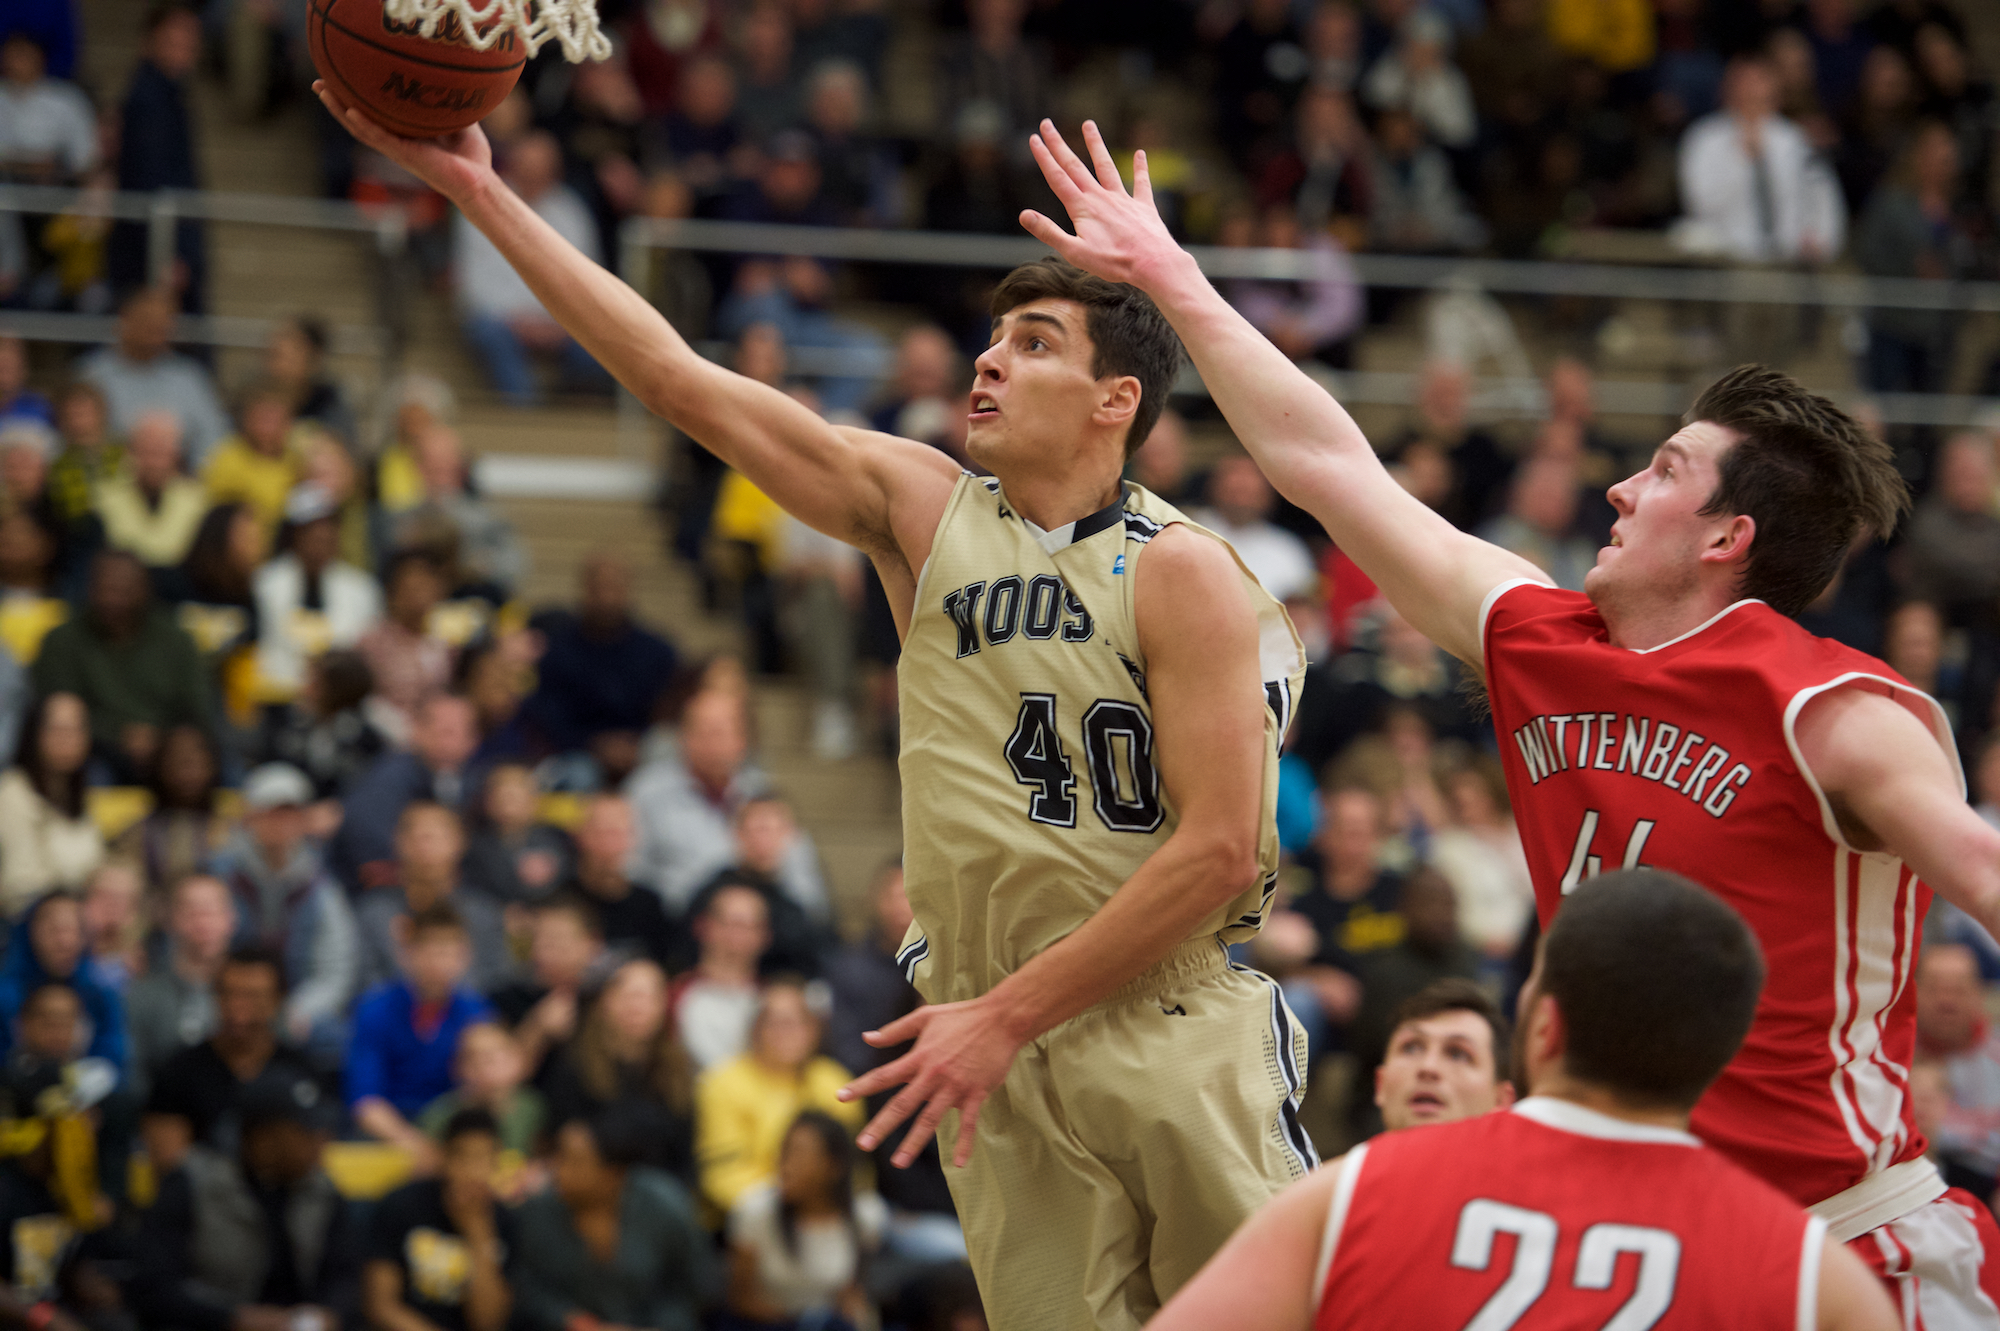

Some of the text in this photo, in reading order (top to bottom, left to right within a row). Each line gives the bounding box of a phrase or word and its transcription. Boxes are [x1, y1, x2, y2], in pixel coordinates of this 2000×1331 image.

[382, 4, 515, 52] Wln
[380, 71, 489, 111] NCAA
[1004, 692, 1166, 833] 40
[1513, 712, 1751, 818] WITTENBERG
[1450, 1197, 1682, 1331] 22
